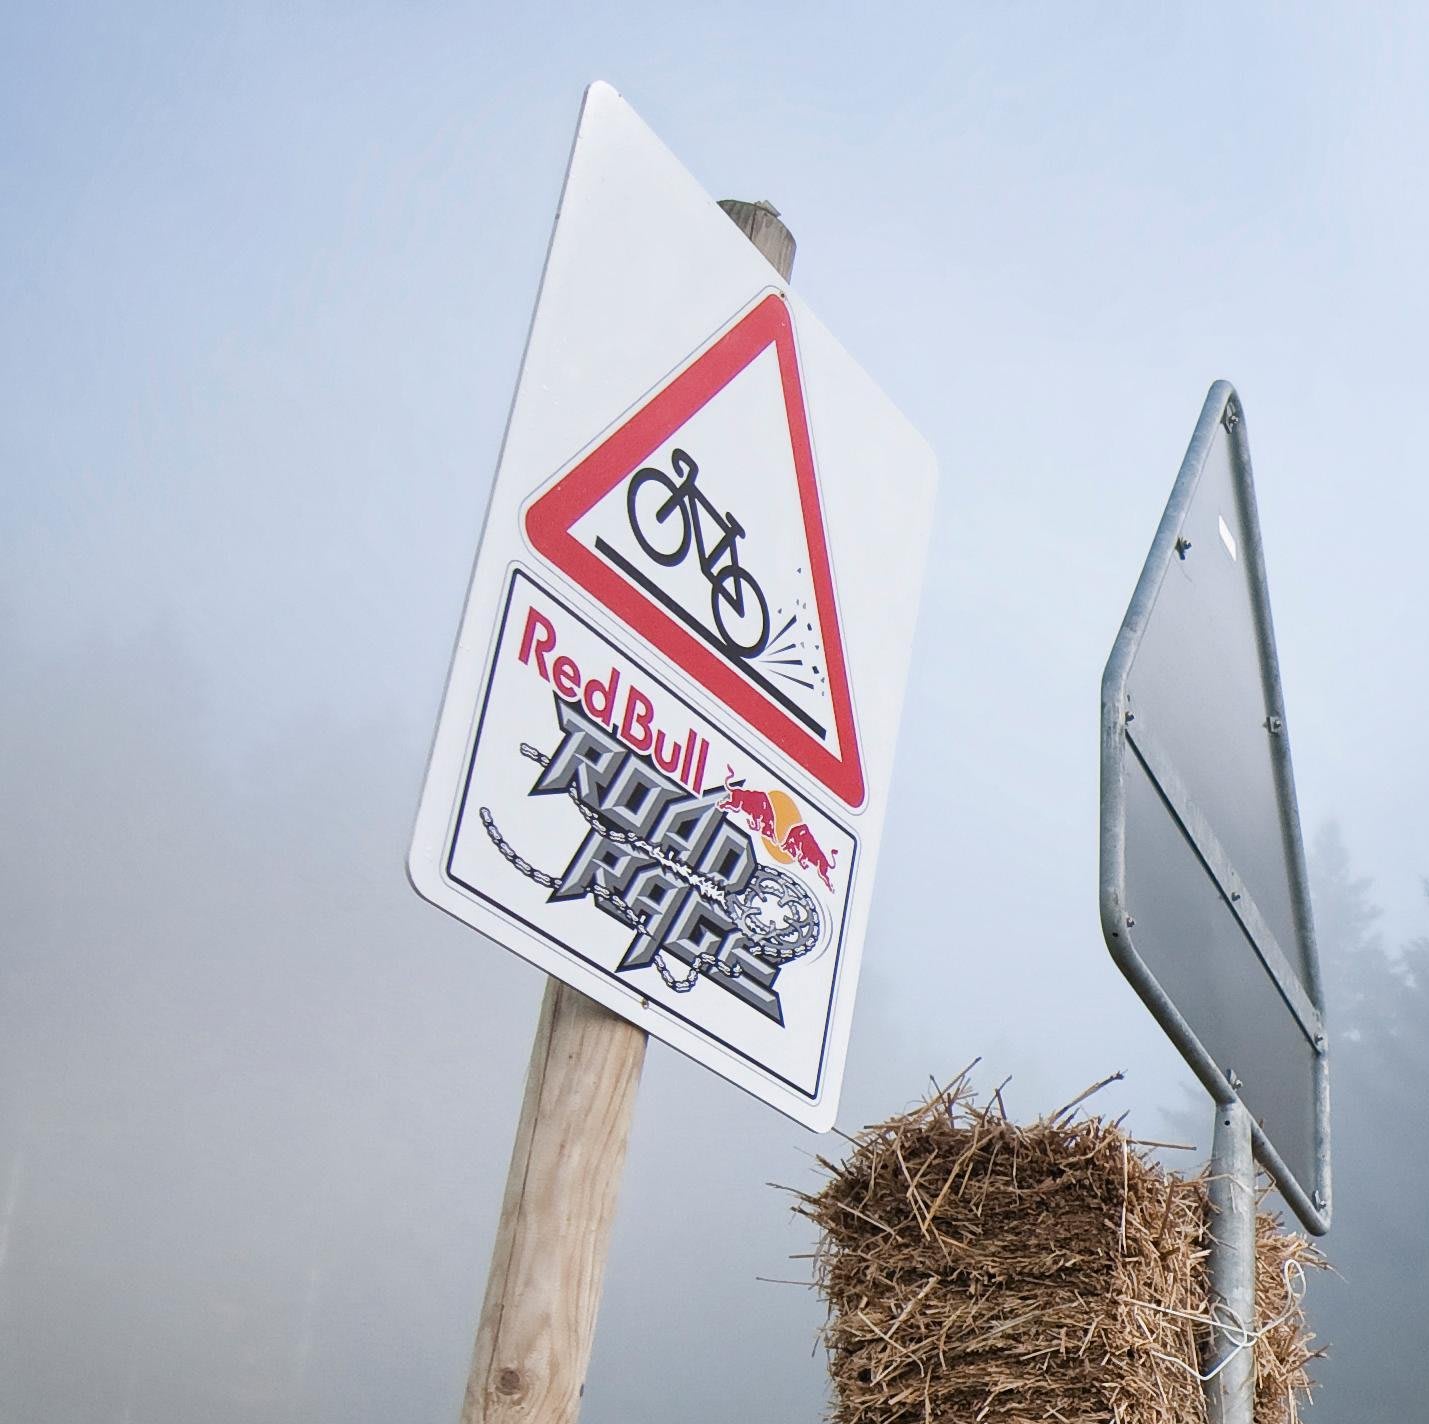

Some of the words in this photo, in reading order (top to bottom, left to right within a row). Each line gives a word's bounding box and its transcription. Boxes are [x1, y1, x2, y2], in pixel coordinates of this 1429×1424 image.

[518, 605, 621, 727] Red
[620, 684, 710, 795] Bull
[528, 690, 758, 897] ROAD
[545, 828, 788, 1028] RAGE
